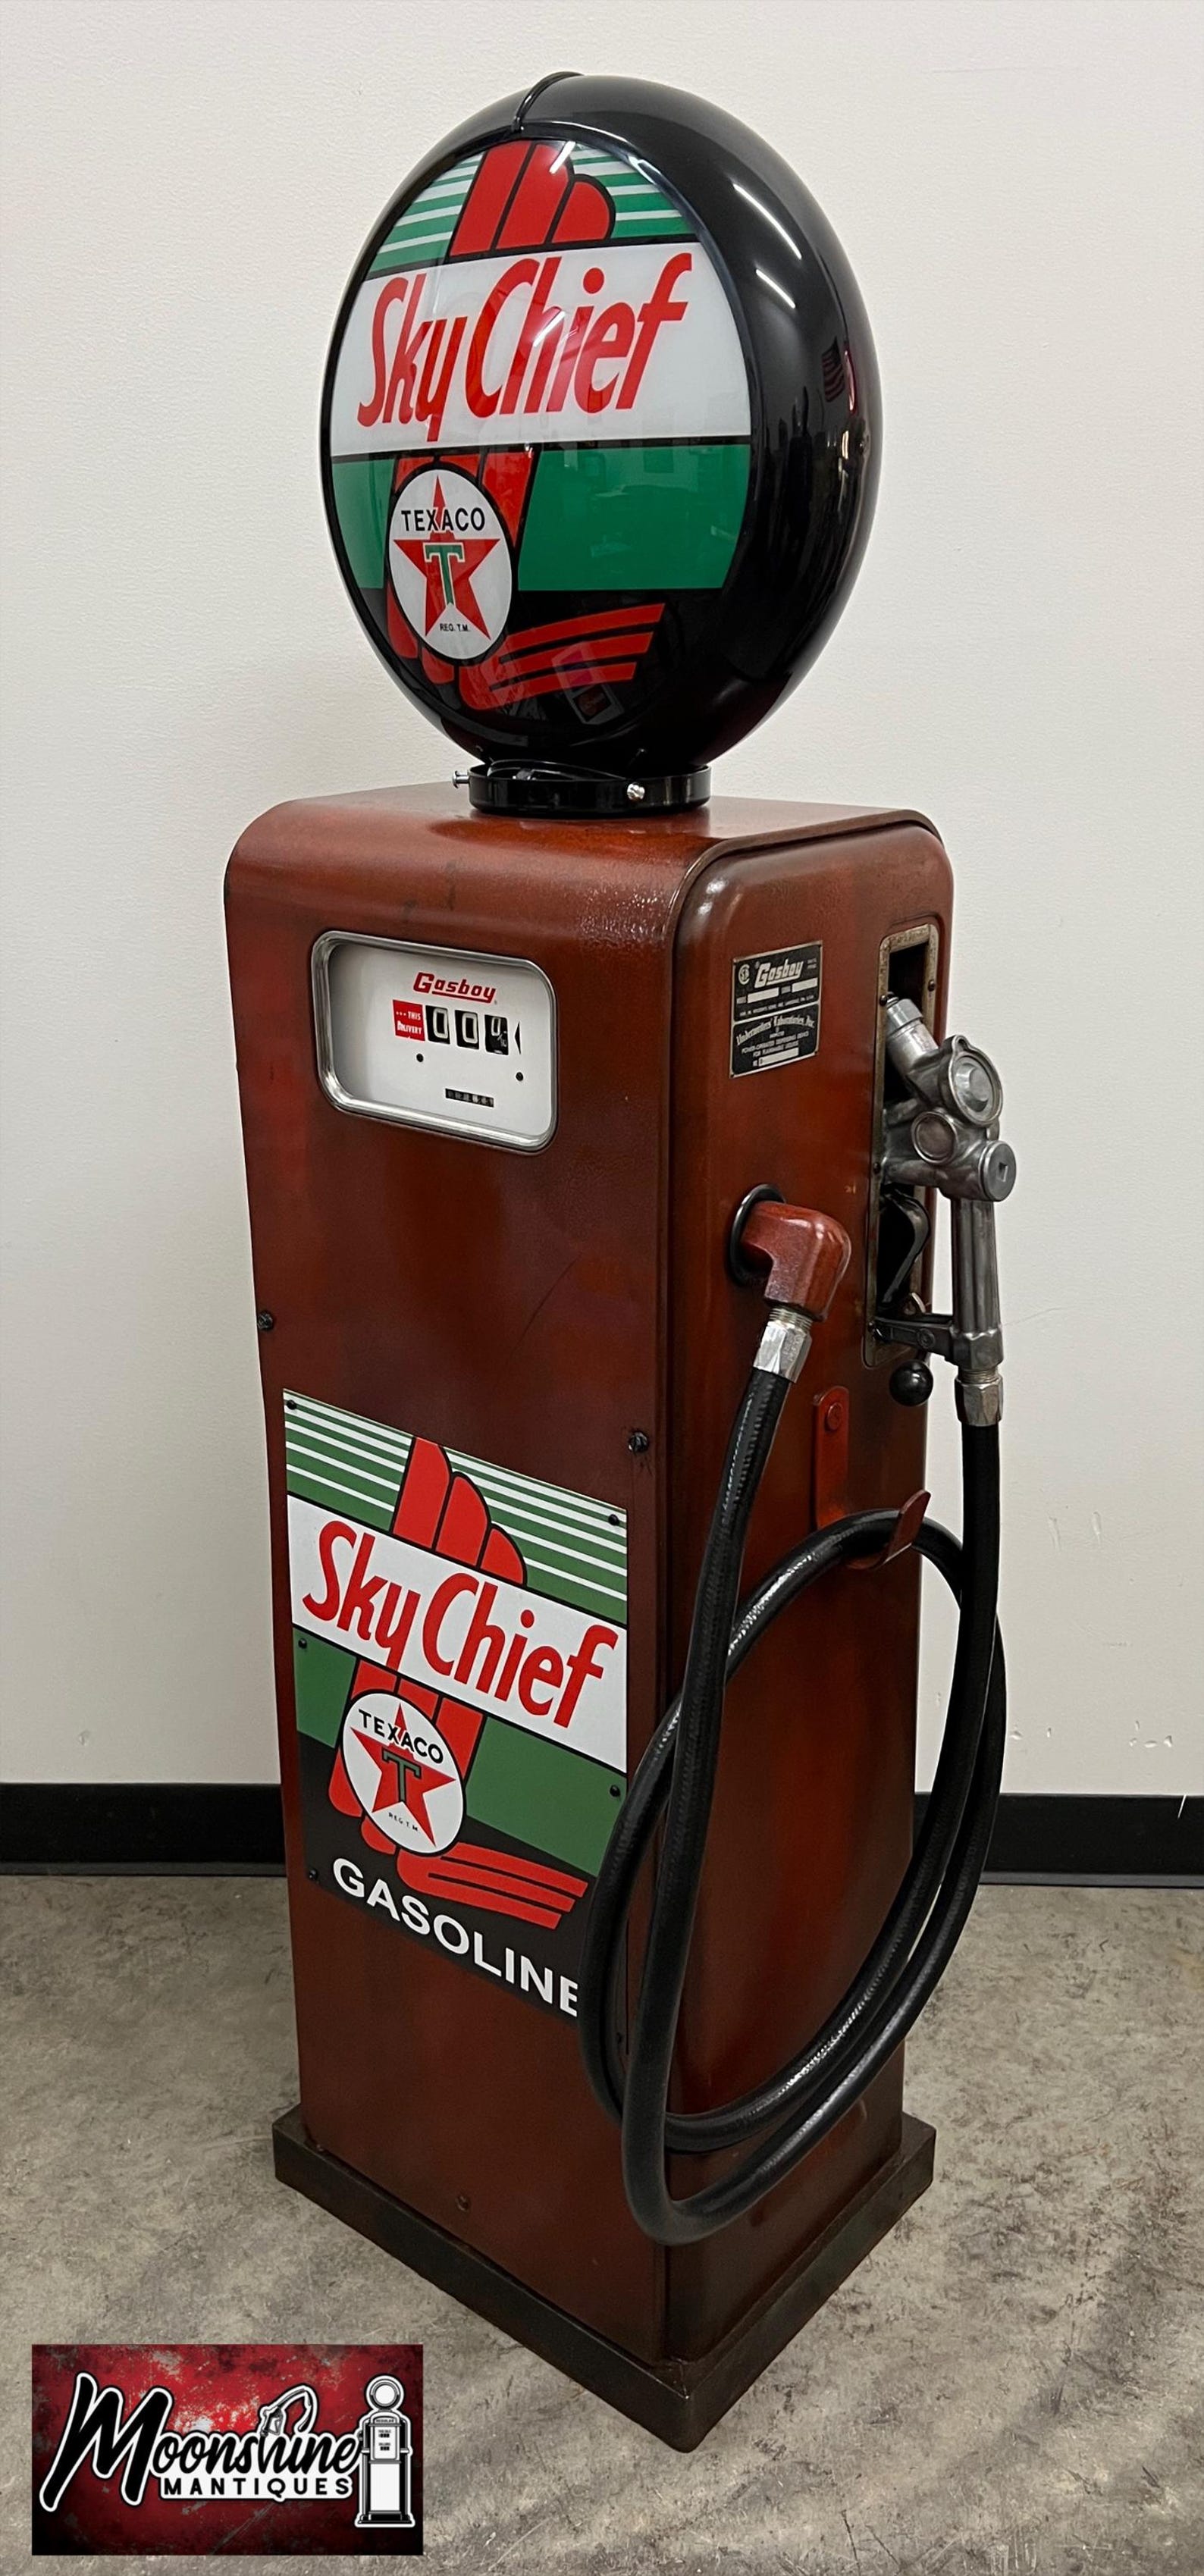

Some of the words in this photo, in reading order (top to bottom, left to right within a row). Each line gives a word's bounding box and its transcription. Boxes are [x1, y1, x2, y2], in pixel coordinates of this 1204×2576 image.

[357, 272, 467, 442] Sky
[463, 252, 693, 418] Chief
[400, 507, 486, 531] TEXACO
[423, 543, 466, 607] T
[413, 972, 497, 1004] Gasboy
[754, 958, 804, 989] Gasboy
[303, 1520, 422, 1671] Sky
[422, 1572, 619, 1730] Chief
[358, 1708, 444, 1764] TEXACO
[381, 1747, 422, 1804] T
[332, 1857, 579, 2018] GASOLINE
